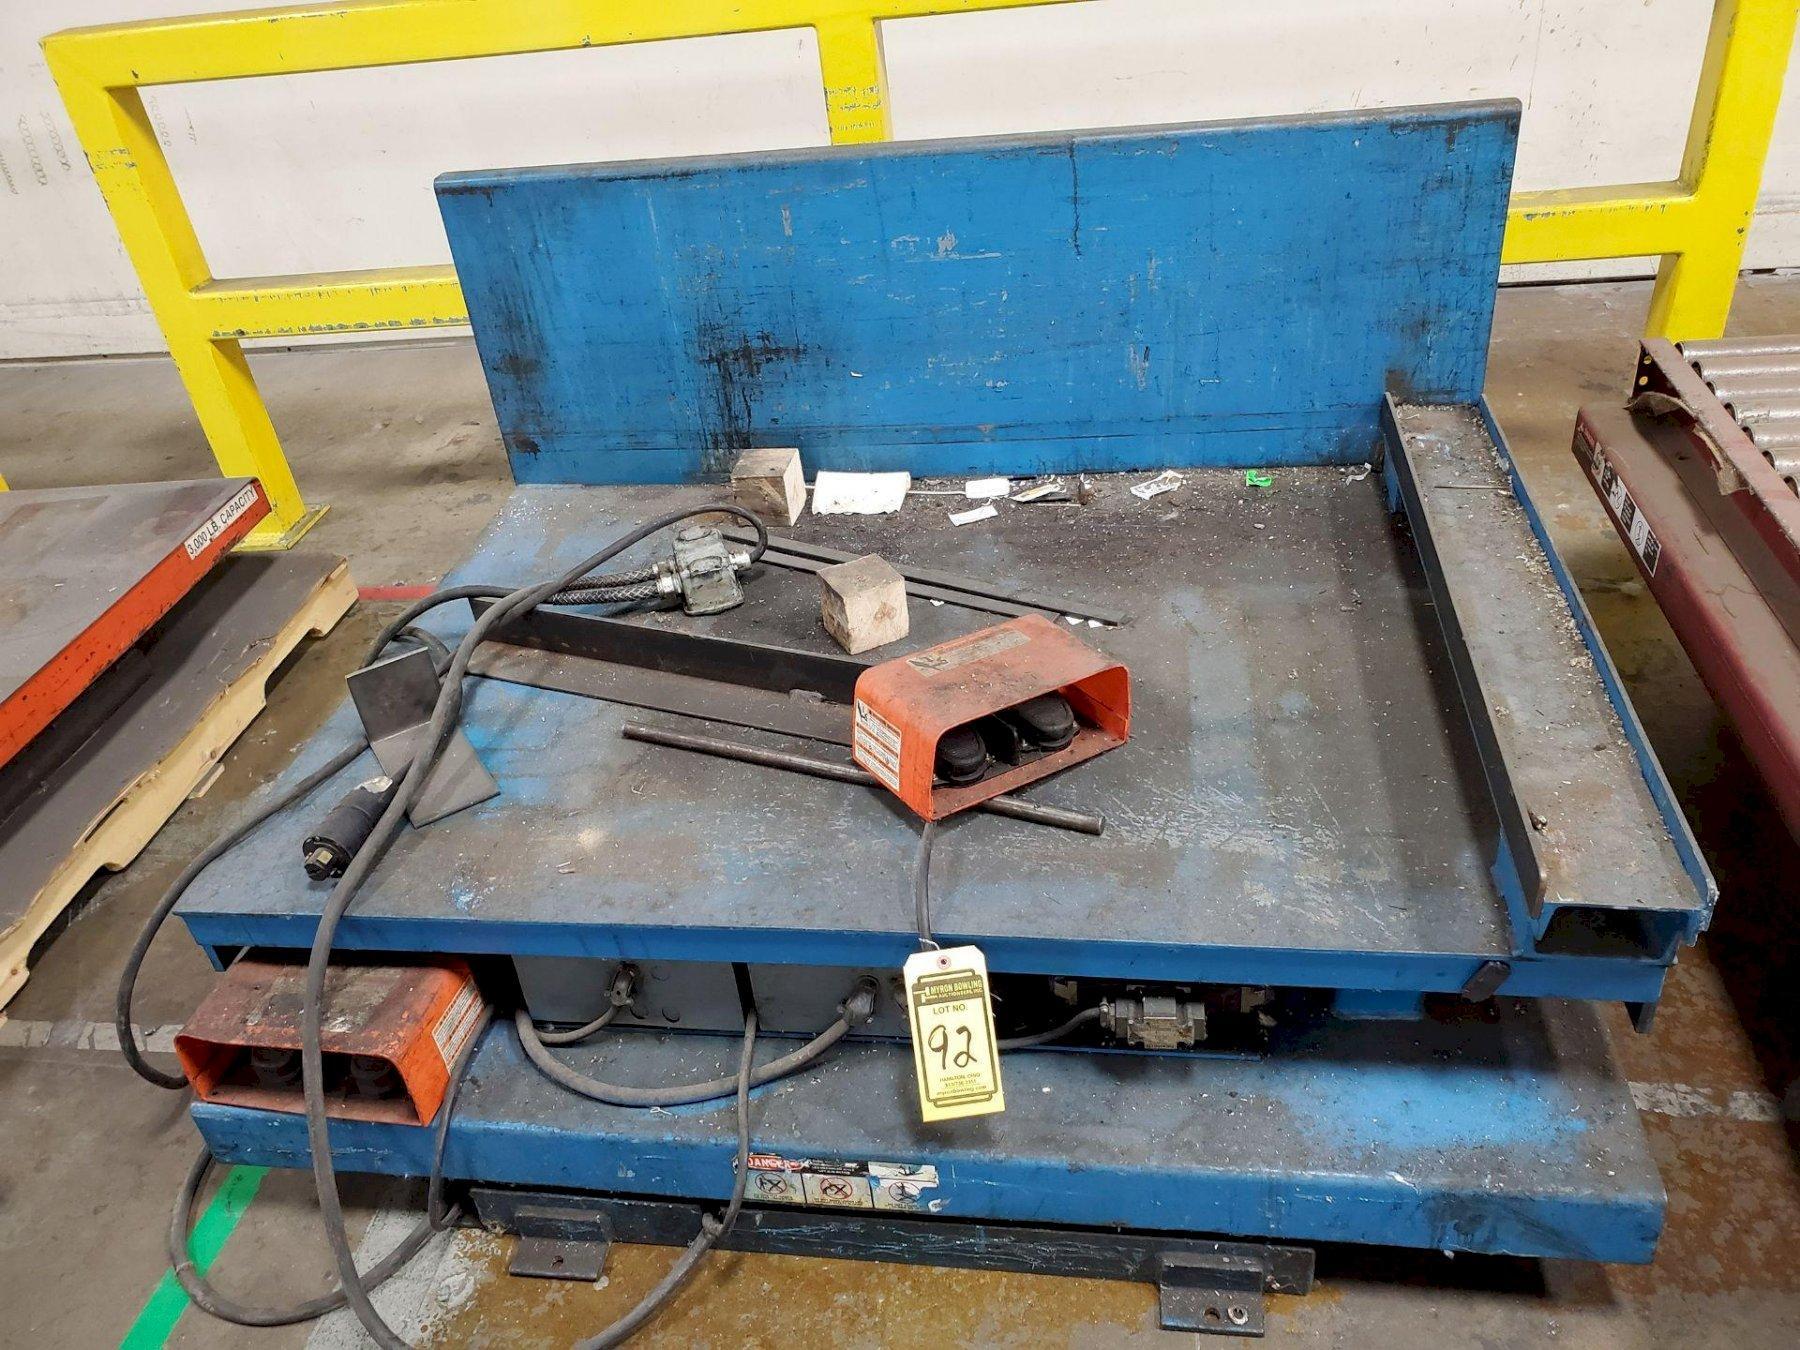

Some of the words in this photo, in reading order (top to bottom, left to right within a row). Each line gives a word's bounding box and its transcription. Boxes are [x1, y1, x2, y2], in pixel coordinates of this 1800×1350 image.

[187, 531, 208, 555] 3,000
[219, 486, 255, 524] CAPACITY
[930, 983, 953, 995] MYRON
[953, 979, 983, 991] BOWLING
[933, 1005, 950, 1015] LOT
[928, 1024, 977, 1070] 92
